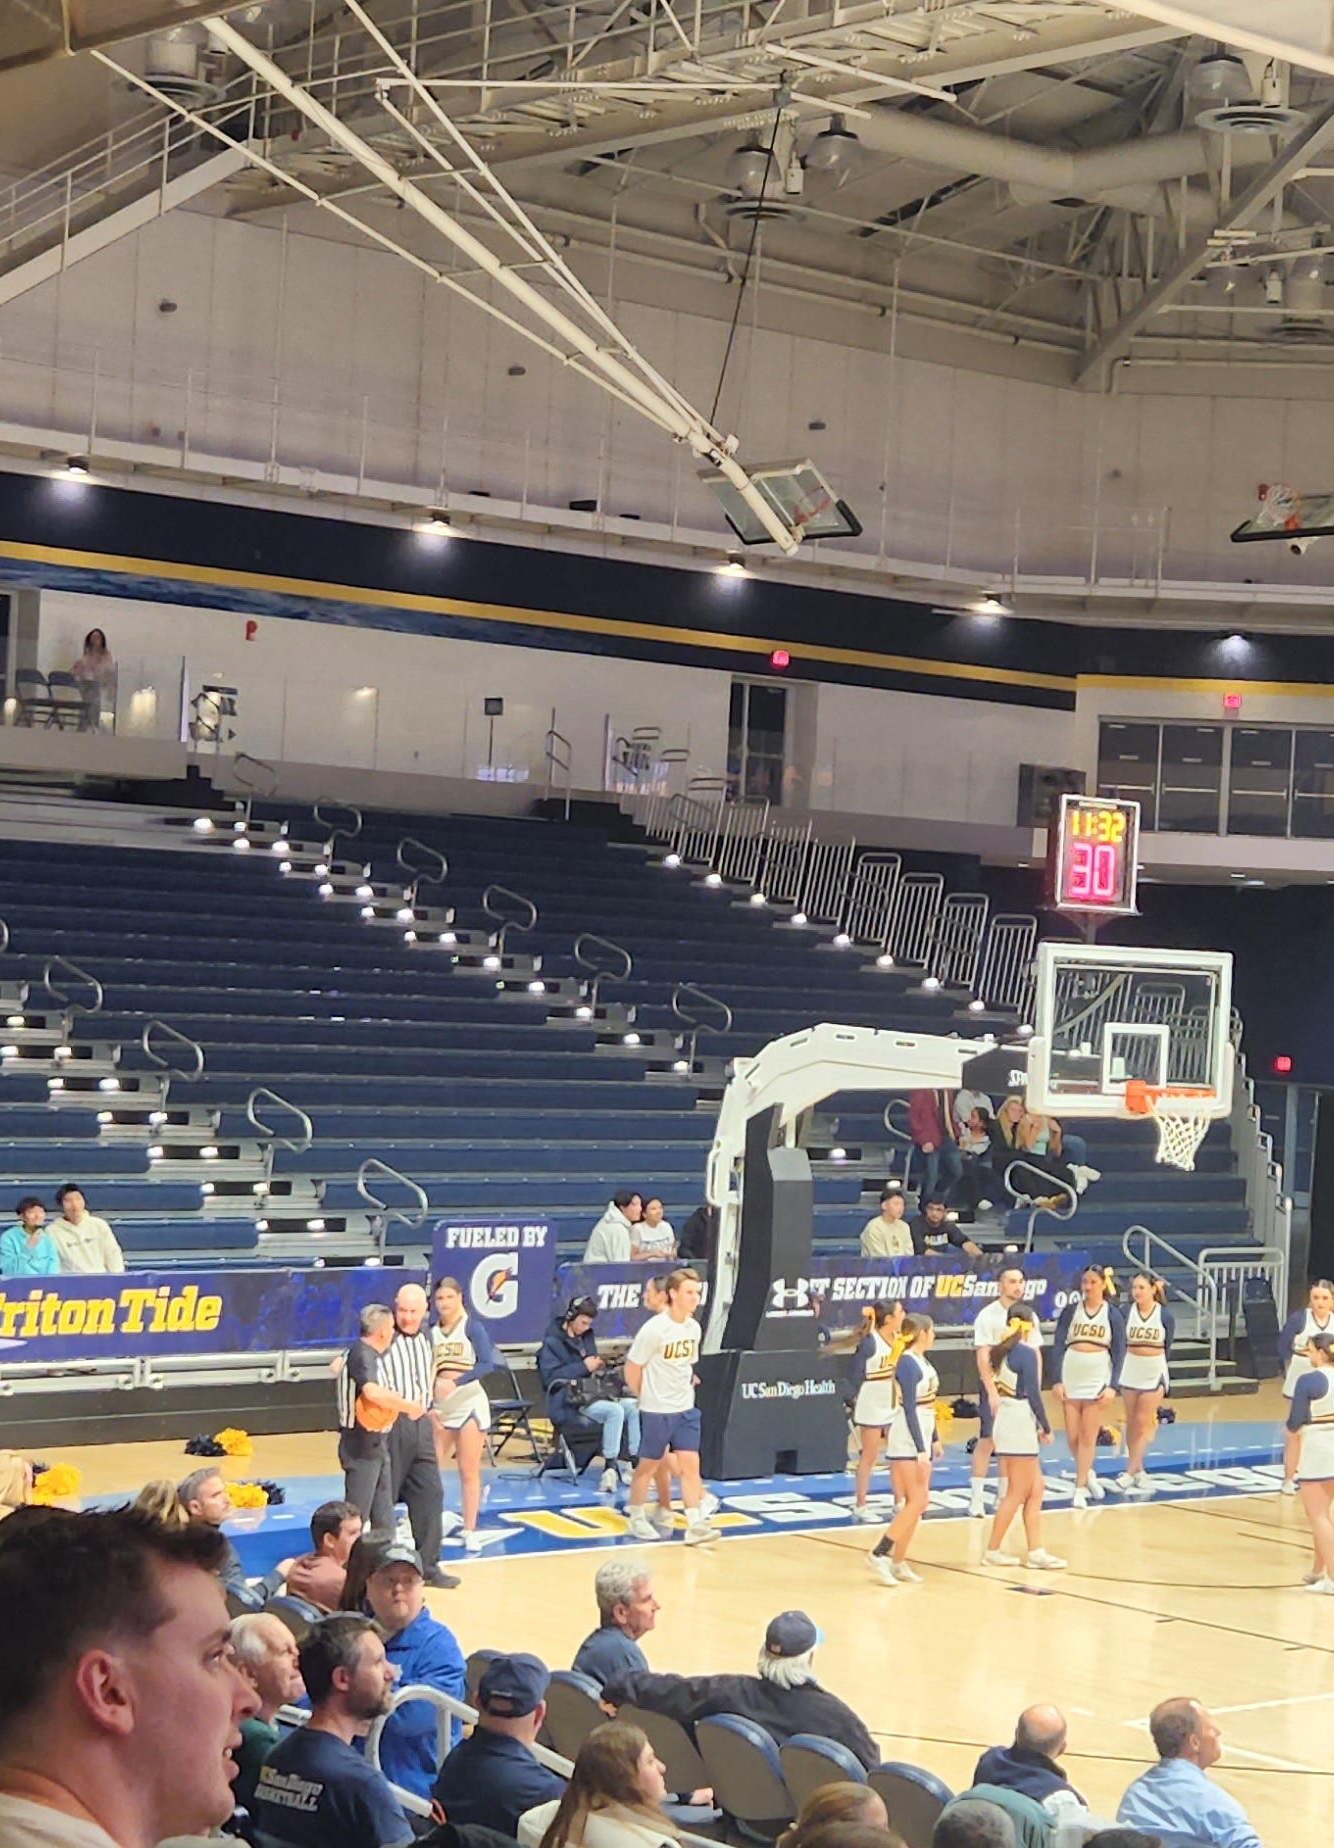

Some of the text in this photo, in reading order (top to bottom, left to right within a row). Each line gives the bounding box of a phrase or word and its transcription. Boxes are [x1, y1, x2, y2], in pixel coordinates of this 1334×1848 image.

[1072, 810, 1126, 844] 11:32
[1071, 842, 1116, 897] 30
[445, 1225, 548, 1249] FUELED BY
[470, 1252, 519, 1319] G
[596, 1284, 643, 1310] THE
[830, 1275, 908, 1301] SECTION
[909, 1275, 936, 1299] OF
[119, 1285, 223, 1334] Tide
[1073, 1323, 1106, 1339] UCSD
[1128, 1326, 1160, 1340] UCSD
[777, 1381, 805, 1399] Diego
[804, 1379, 836, 1396] Health
